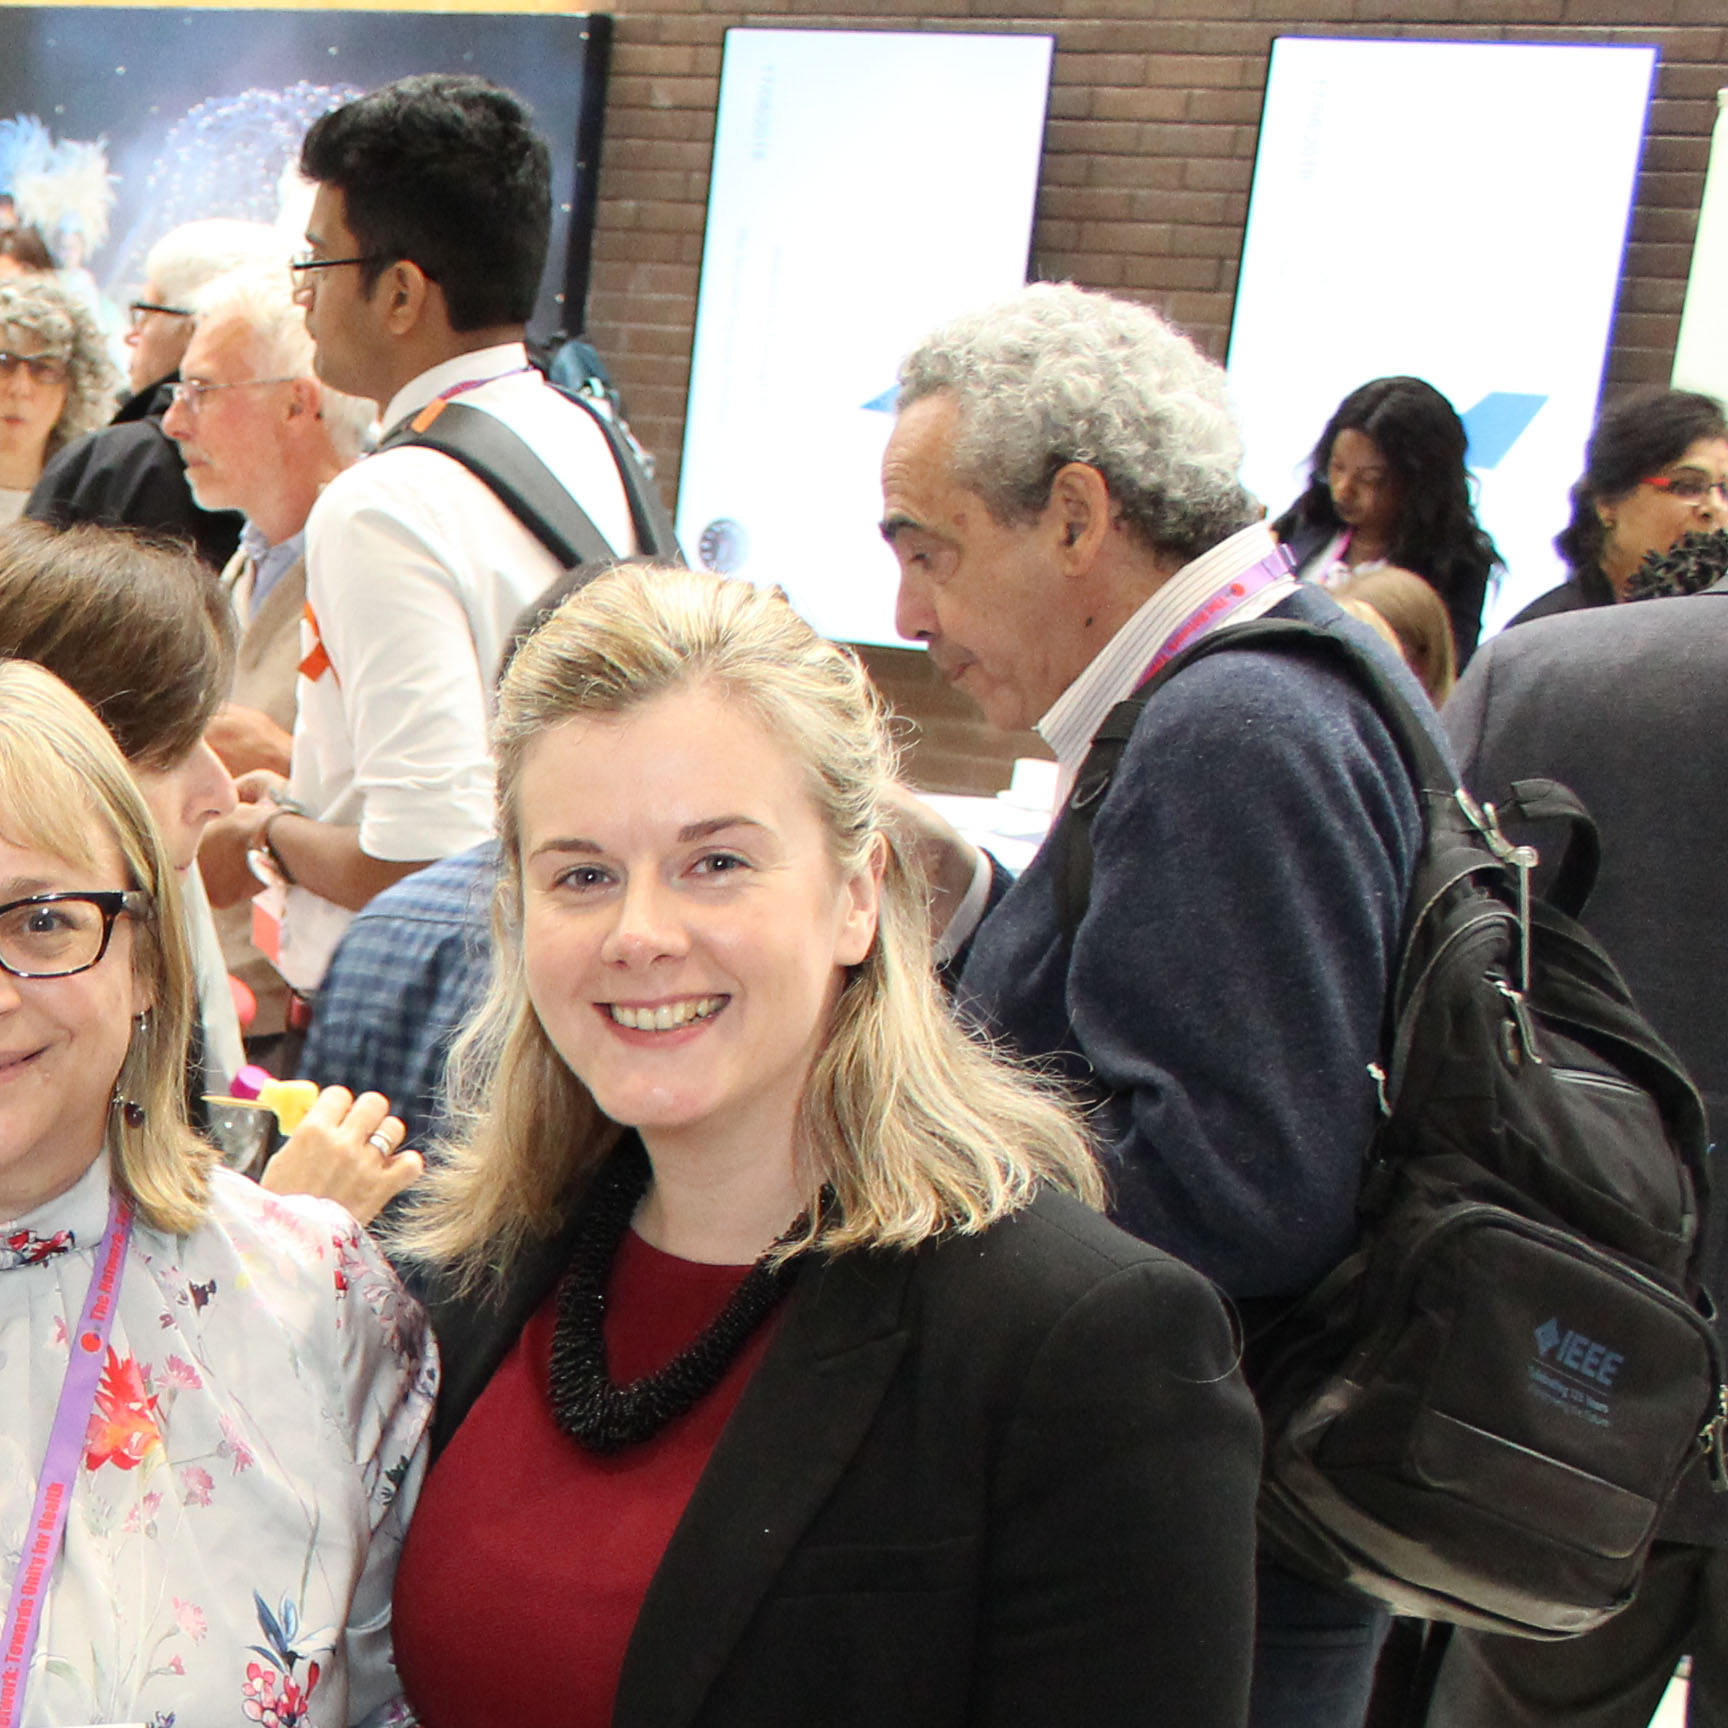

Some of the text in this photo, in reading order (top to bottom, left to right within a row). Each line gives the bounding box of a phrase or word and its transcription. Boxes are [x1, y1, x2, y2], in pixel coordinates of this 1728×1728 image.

[1556, 1329, 1625, 1386] IEEE
[38, 1481, 65, 1531] Health
[31, 1532, 51, 1555] for
[21, 1556, 48, 1596] Unity
[5, 1598, 35, 1663] Towards
